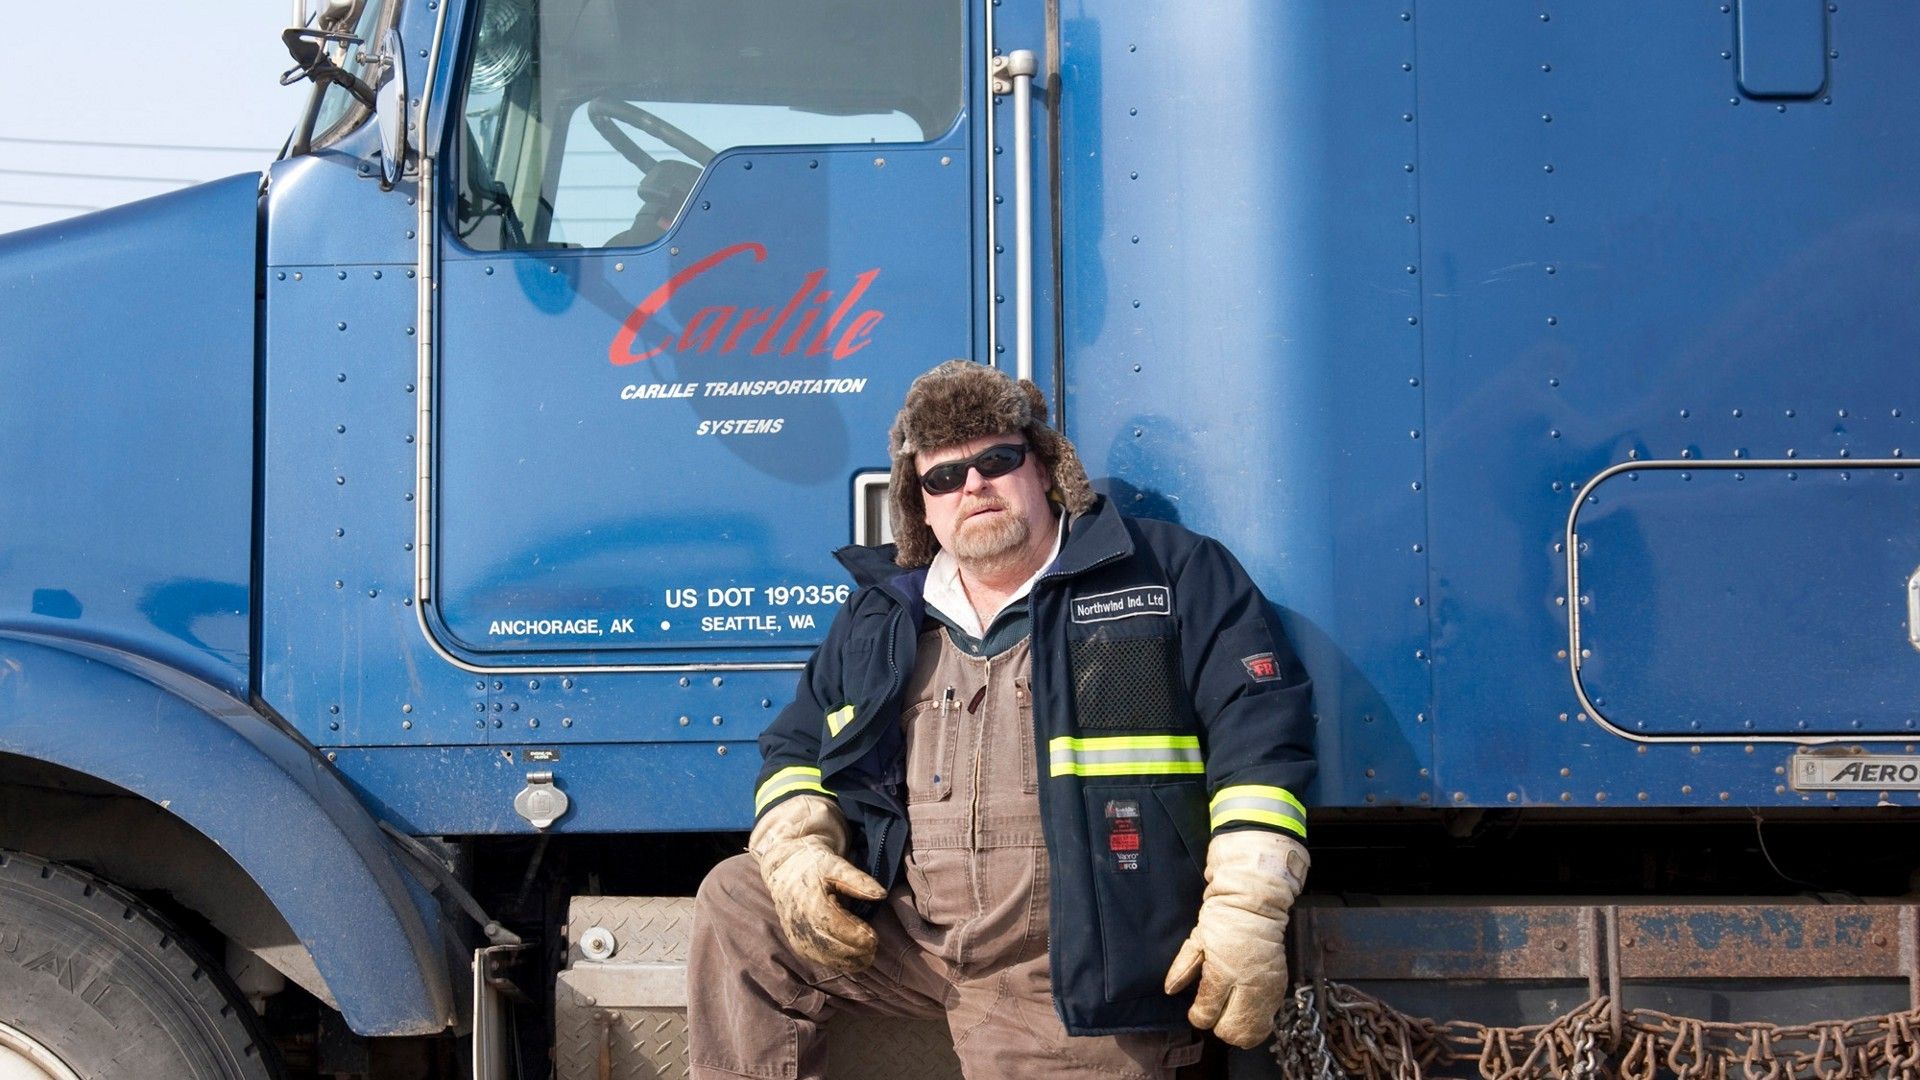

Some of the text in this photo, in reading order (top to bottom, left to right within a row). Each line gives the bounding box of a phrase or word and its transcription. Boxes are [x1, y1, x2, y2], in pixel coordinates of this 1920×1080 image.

[609, 242, 885, 367] Carlile
[620, 378, 868, 400] CARLILE TRANSPORTATION
[696, 418, 785, 436] SYSTEMS
[665, 584, 850, 609] US DOT 190356
[1077, 593, 1164, 616] Northwind Ind. Ltd
[488, 614, 816, 637] ANCHORAGE, AK SEATTLE, WA
[1830, 762, 1920, 782] AERO
